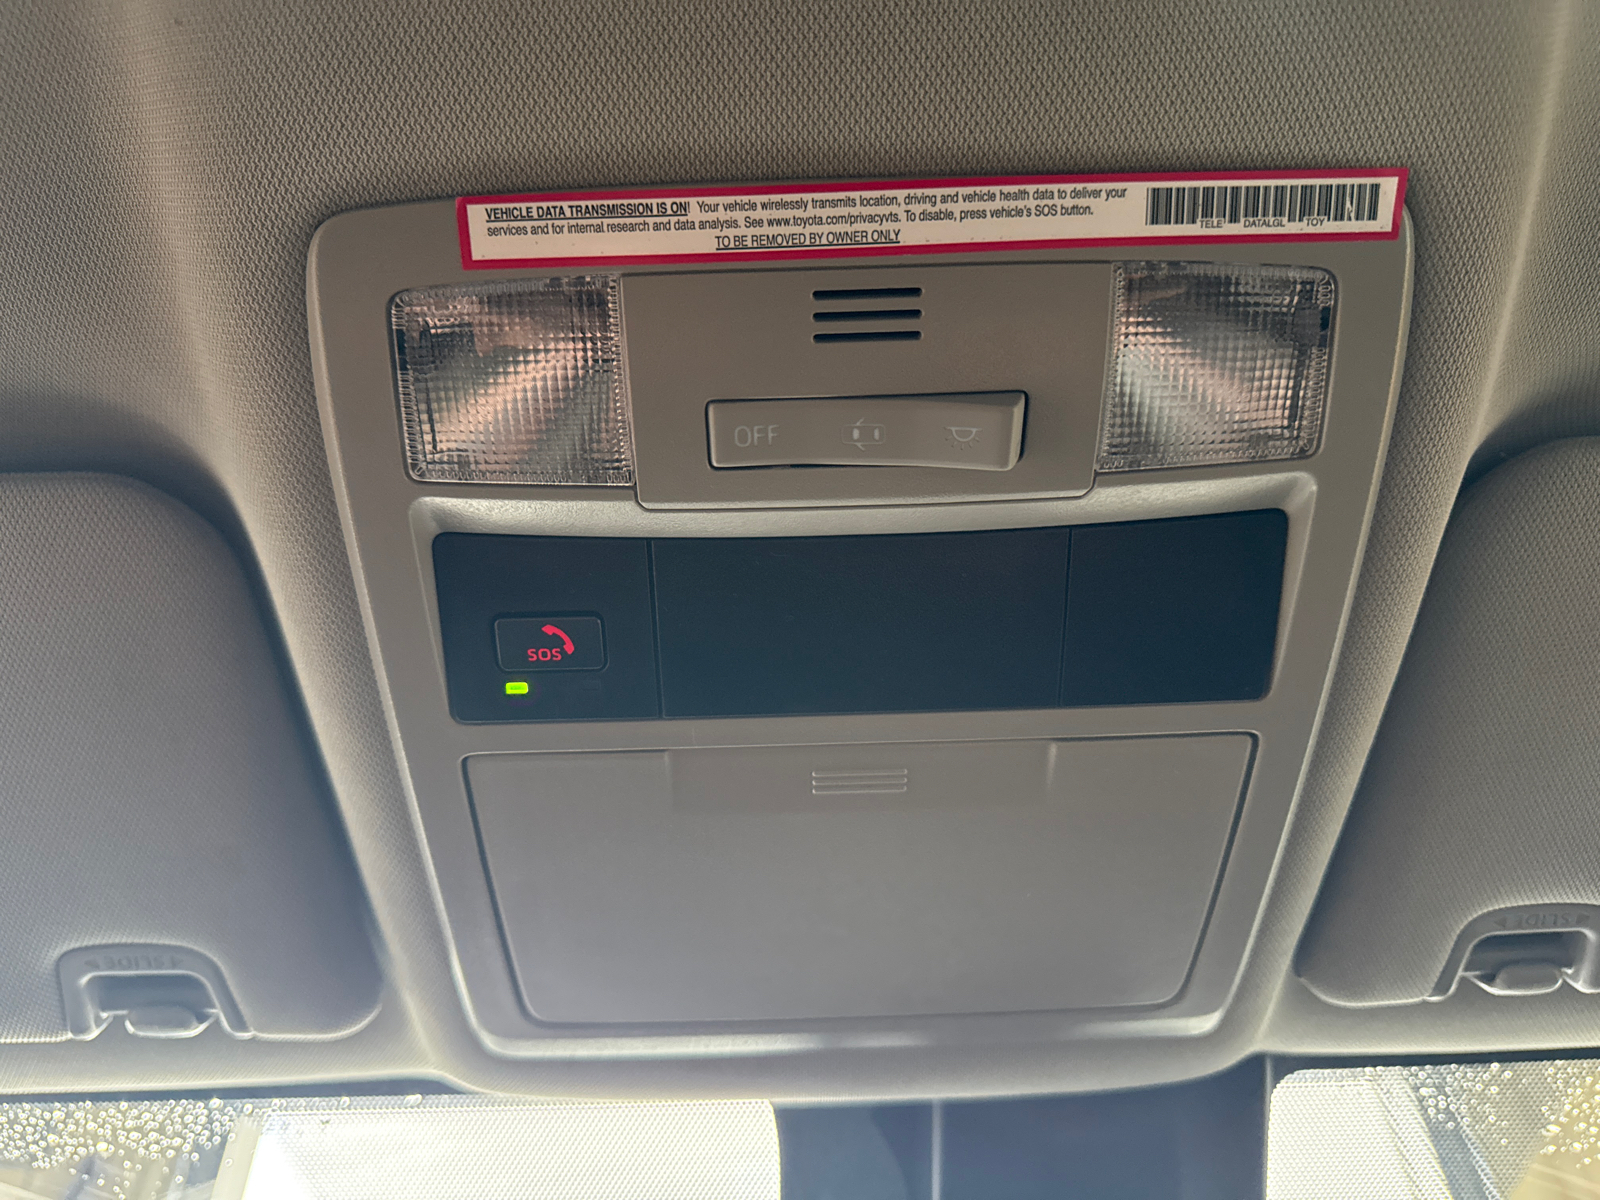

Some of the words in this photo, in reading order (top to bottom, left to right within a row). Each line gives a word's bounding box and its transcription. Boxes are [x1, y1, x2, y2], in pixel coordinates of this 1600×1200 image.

[485, 206, 533, 220] VEHICLE
[536, 205, 566, 218] DATA
[568, 202, 653, 217] TRANSMISSION
[656, 202, 667, 214] IS
[670, 201, 690, 214] ON!
[697, 200, 720, 214] Your
[722, 199, 757, 213] vehicle
[760, 198, 808, 213] wirelessly
[811, 195, 857, 209] transmits
[859, 194, 901, 208] location,
[904, 193, 937, 207] driving
[940, 191, 959, 204] and
[962, 190, 996, 203] vehicle
[999, 187, 1030, 202] health
[1032, 188, 1055, 201] data
[1057, 188, 1067, 200] to
[1069, 187, 1102, 199] deliver
[1105, 188, 1127, 201] your
[487, 223, 528, 237] services
[530, 222, 549, 236] and
[551, 222, 565, 235] for
[567, 221, 605, 235] internal
[606, 219, 650, 234] research
[652, 219, 671, 232] and
[673, 218, 696, 231] data
[698, 216, 741, 232] analysis.
[744, 216, 764, 229] See
[766, 211, 902, 230] www.toyota.com/privacyvts.
[904, 209, 916, 222] To
[918, 208, 957, 222] disable,
[959, 209, 987, 222] press
[989, 205, 1032, 219] vehicle's
[1034, 204, 1058, 217] SOS
[1060, 204, 1094, 216] button.
[1200, 218, 1223, 229] TELE
[1243, 218, 1286, 229] DATALGL
[1305, 217, 1326, 227] TOY
[715, 235, 731, 248] TO
[733, 235, 748, 247] BE
[751, 232, 806, 246] REMOVED
[809, 231, 824, 244] BY
[826, 229, 868, 244] OWNER
[870, 228, 901, 242] ONLY
[734, 424, 780, 447] OFF
[527, 648, 562, 661] SOS
